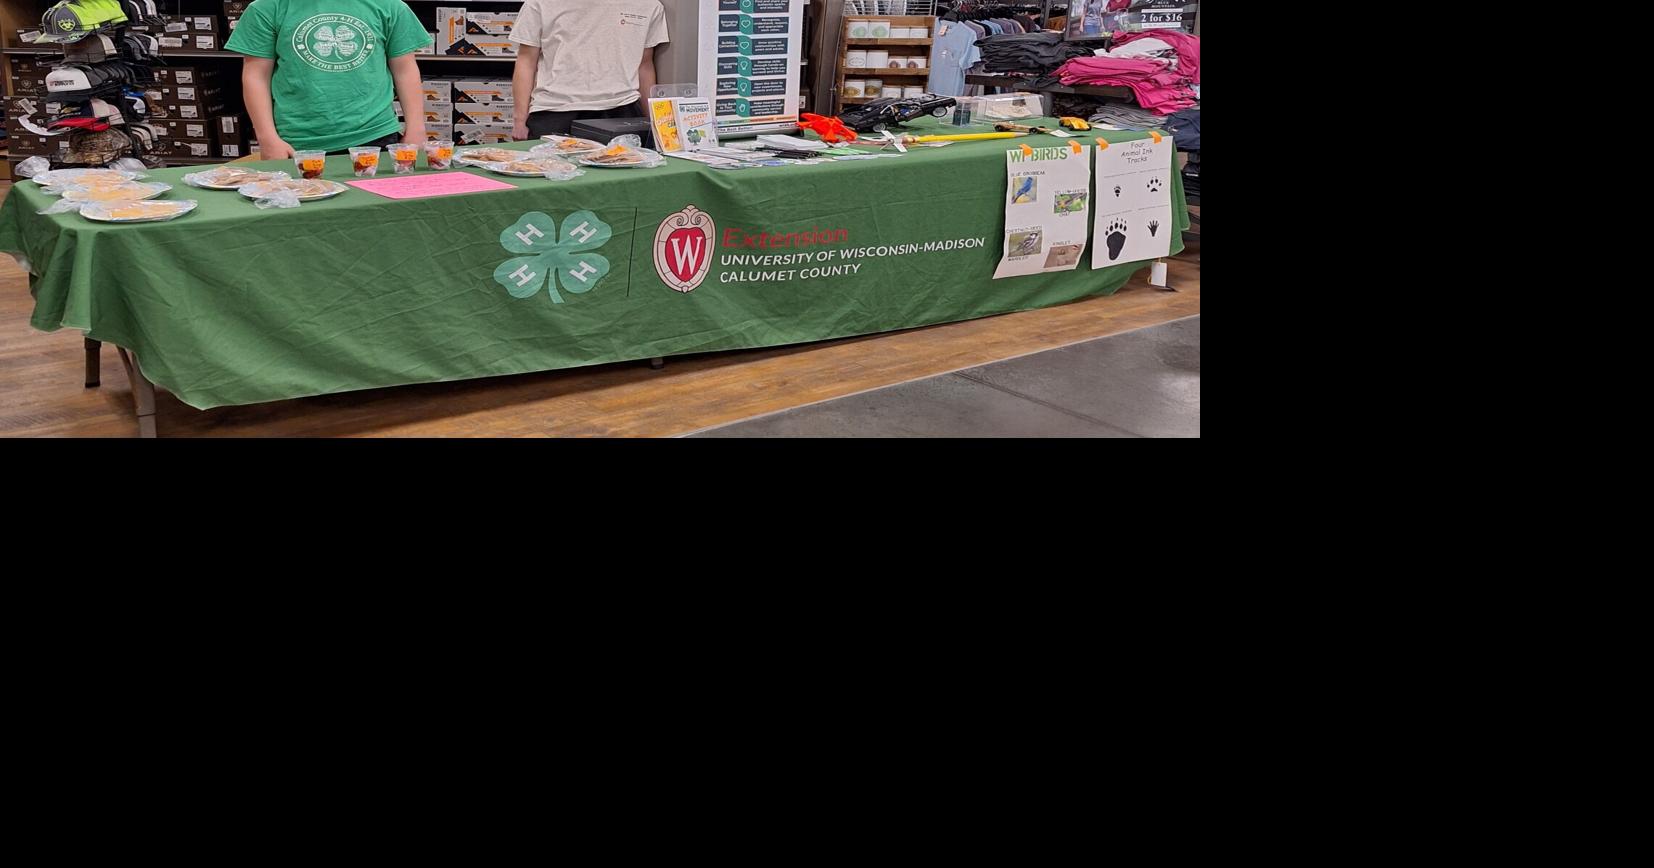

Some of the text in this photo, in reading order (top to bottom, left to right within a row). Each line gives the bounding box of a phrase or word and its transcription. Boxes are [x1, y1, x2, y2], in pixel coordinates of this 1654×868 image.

[1141, 13, 1182, 22] 2 for $16
[303, 50, 318, 64] MAKE
[1031, 148, 1068, 161] BIRDS
[1121, 149, 1141, 157] Animal
[515, 221, 598, 246] H H
[722, 225, 848, 249] Extension
[670, 234, 703, 275] W
[721, 237, 985, 266] UNIVERSITY OF WISCONSIN-MADISON
[508, 264, 536, 287] H
[570, 260, 598, 282] H
[720, 263, 861, 283] CALUMET COUNTY
